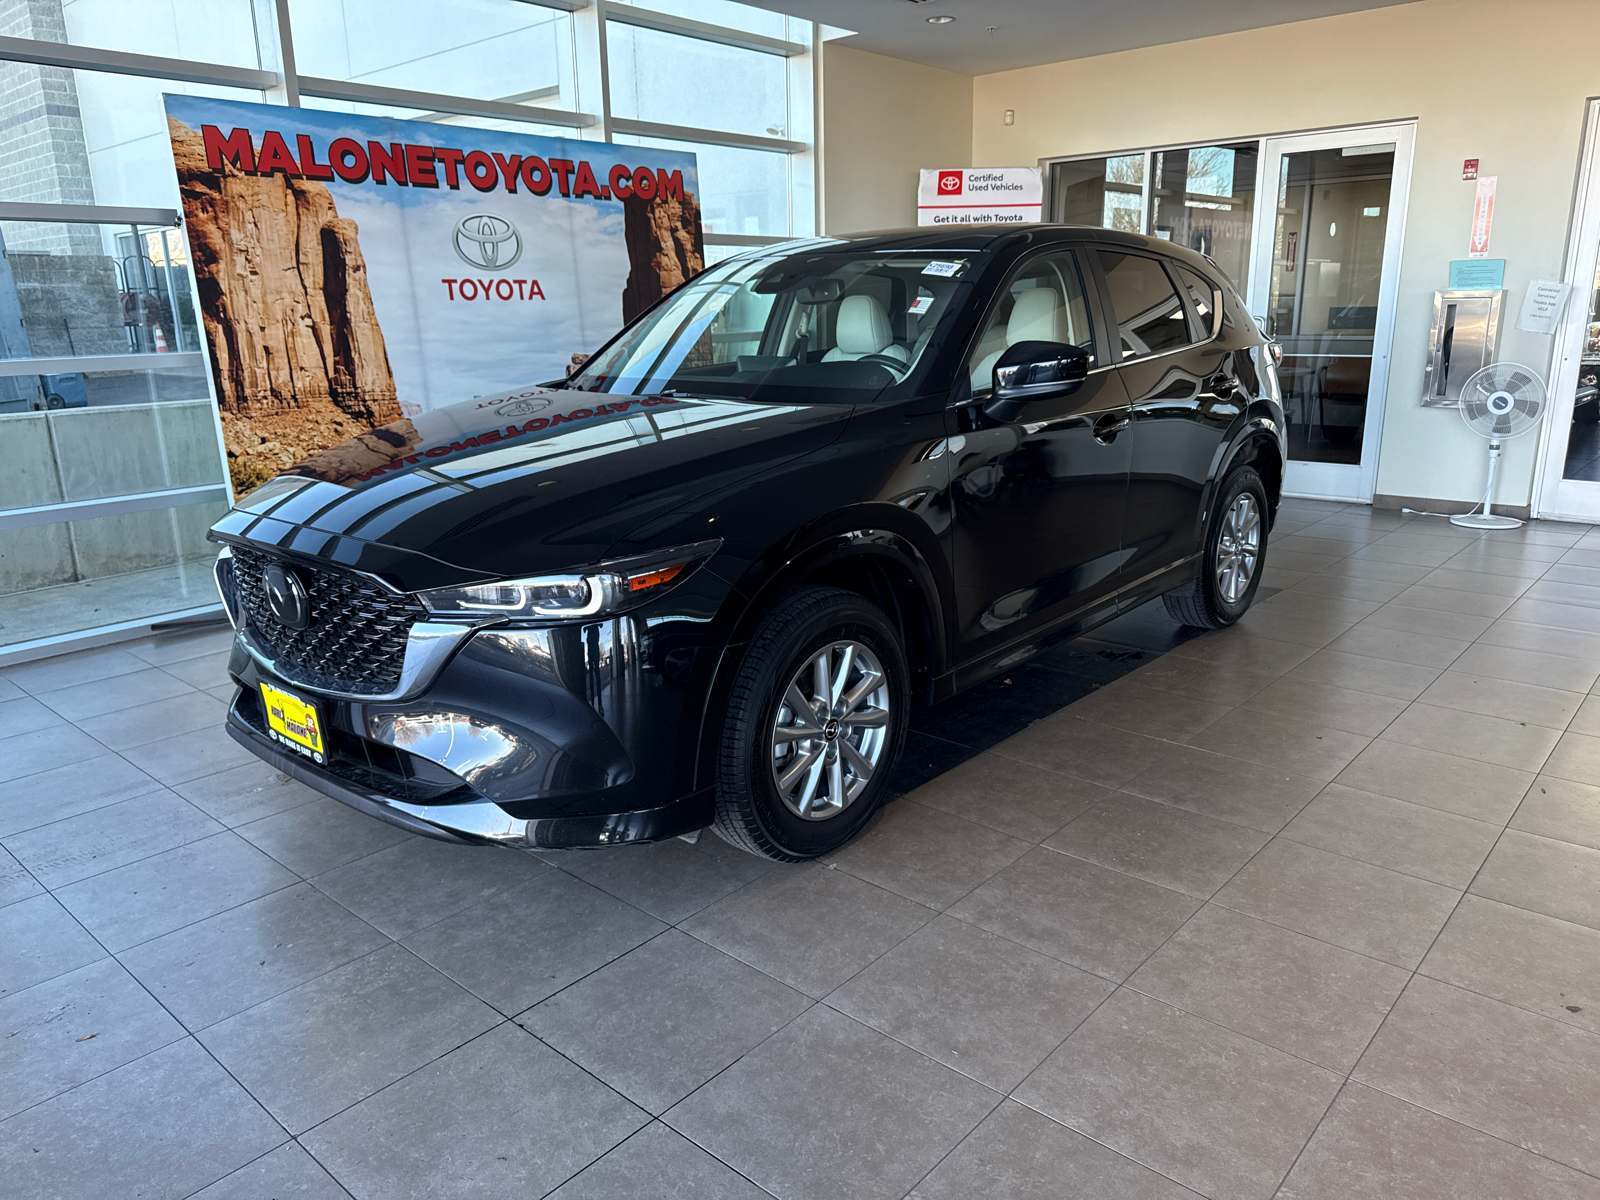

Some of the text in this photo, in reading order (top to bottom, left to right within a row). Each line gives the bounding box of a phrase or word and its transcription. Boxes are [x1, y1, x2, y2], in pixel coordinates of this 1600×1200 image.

[201, 124, 684, 202] MALONETOYOTA.COM
[968, 174, 1004, 182] Certified
[968, 183, 1024, 192] Used Vehicles
[933, 213, 1023, 223] Get it all with Toyota
[442, 278, 546, 302] TOYOTA
